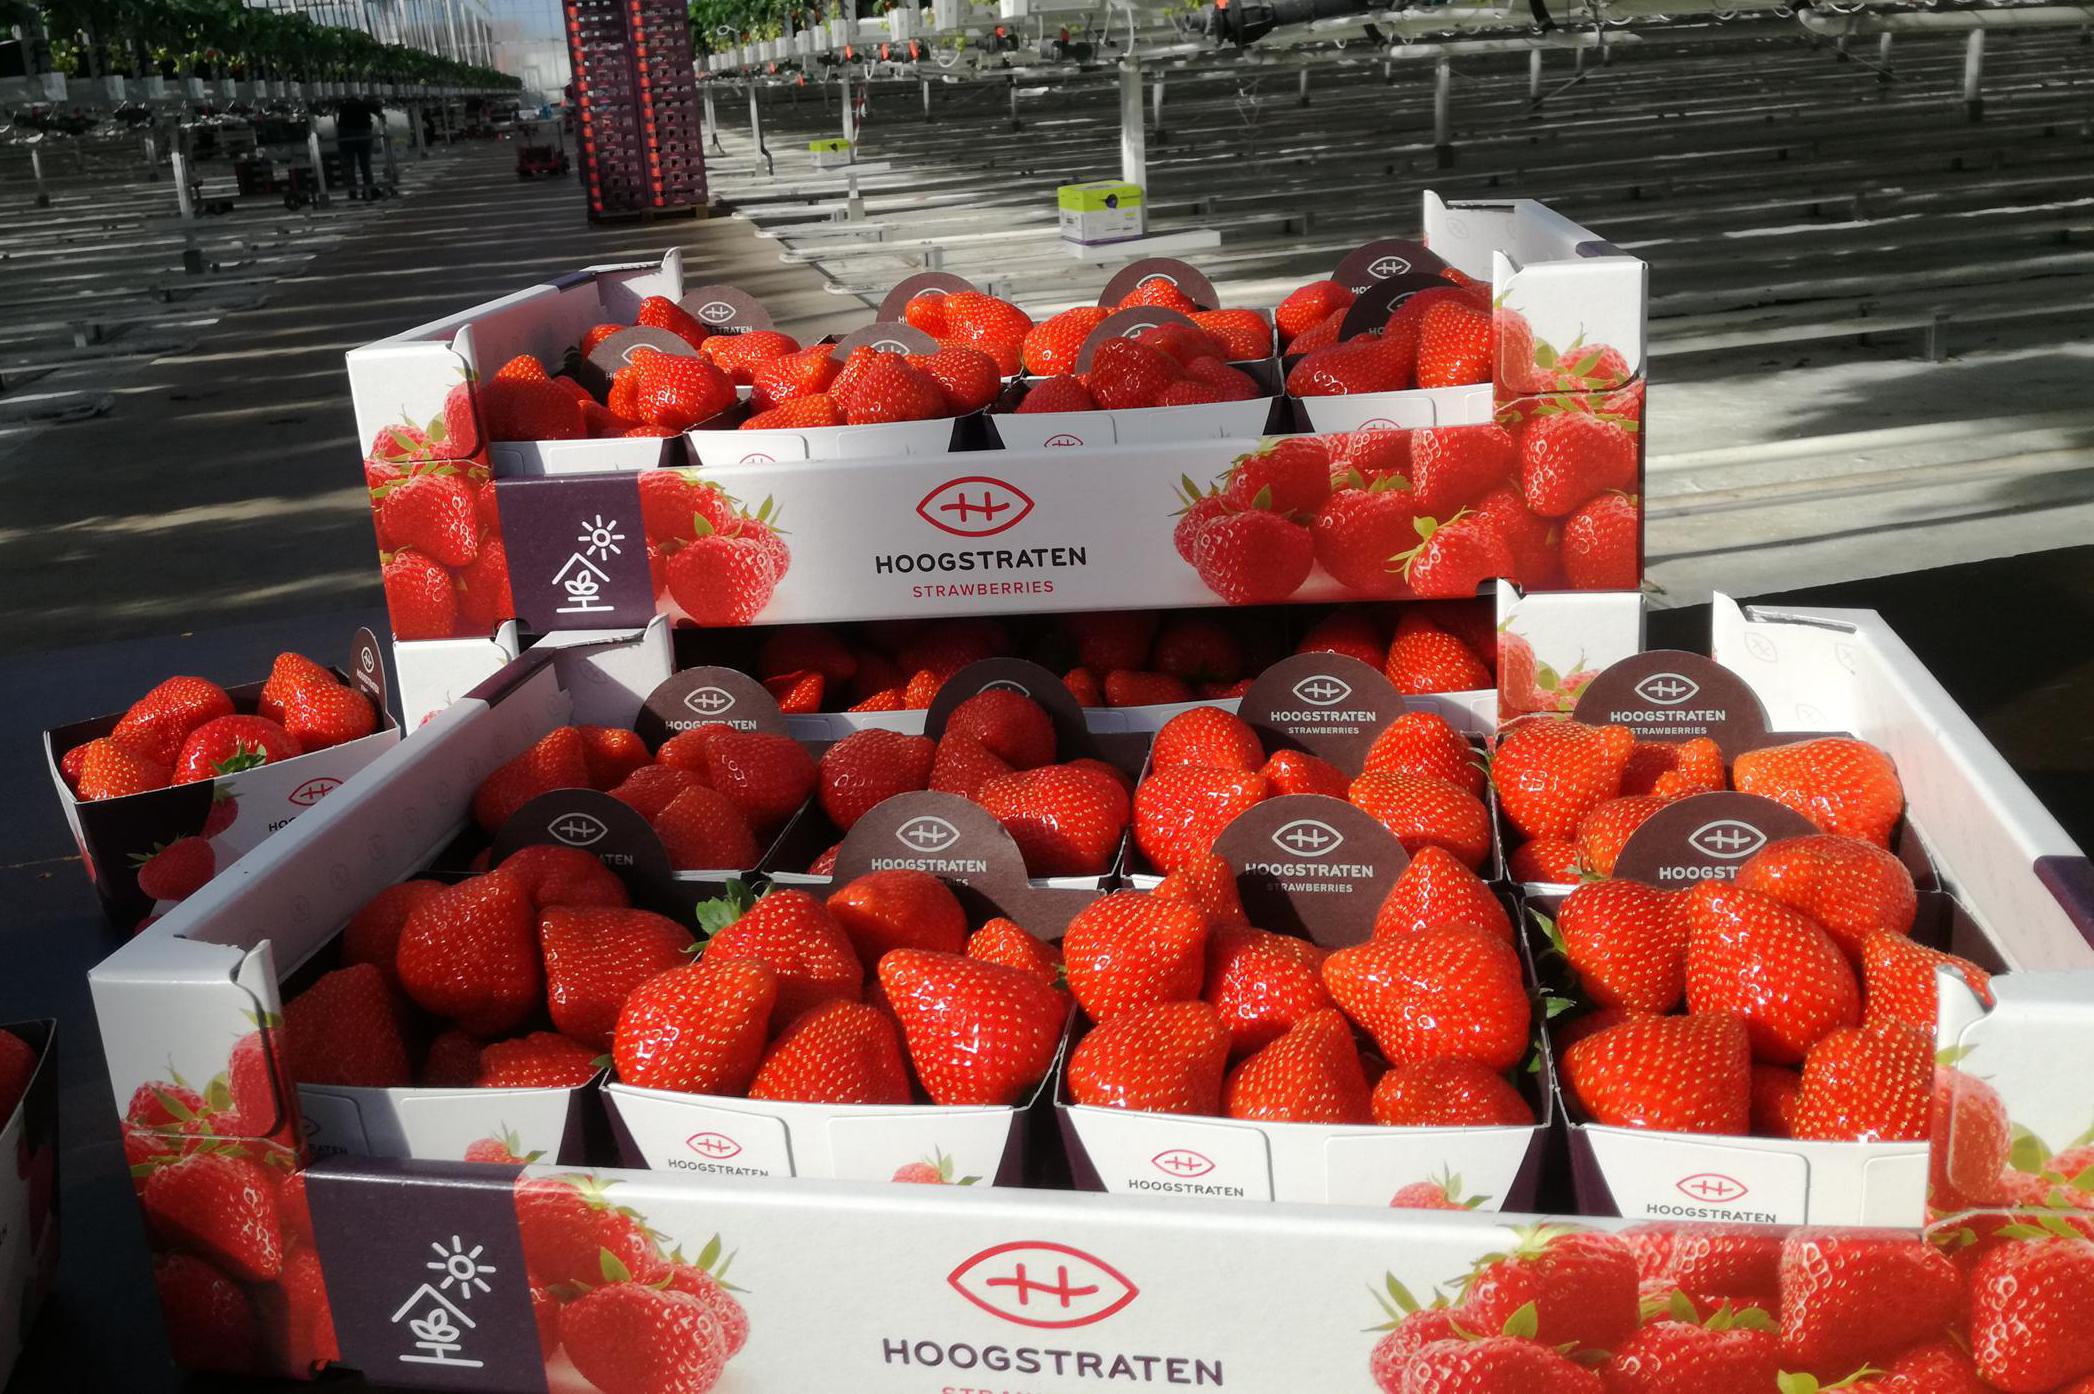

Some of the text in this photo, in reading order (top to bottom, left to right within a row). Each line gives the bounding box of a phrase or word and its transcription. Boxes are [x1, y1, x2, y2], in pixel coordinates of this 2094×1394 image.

[875, 547, 1087, 574] HOOGSTRATEN
[912, 580, 1055, 598] STRAWBERRIES
[1270, 711, 1376, 722] HOOGSTRATEN
[1610, 709, 1726, 722] HOOGSTRATEN
[1288, 726, 1360, 735] STRAWBERRIES
[1630, 726, 1707, 735] STRAWBERRIES
[871, 858, 987, 873] HOOGSTRATEN
[1245, 862, 1374, 878] HOOGSTRATEN
[1659, 865, 1739, 880] HOOGST
[667, 1158, 769, 1177] HOOGSTRATEN
[1128, 1179, 1245, 1198] HOOGSTRATEN
[1646, 1203, 1777, 1224] HOOGSTRATEN
[882, 1337, 1224, 1387] HOOGSTRATEN
